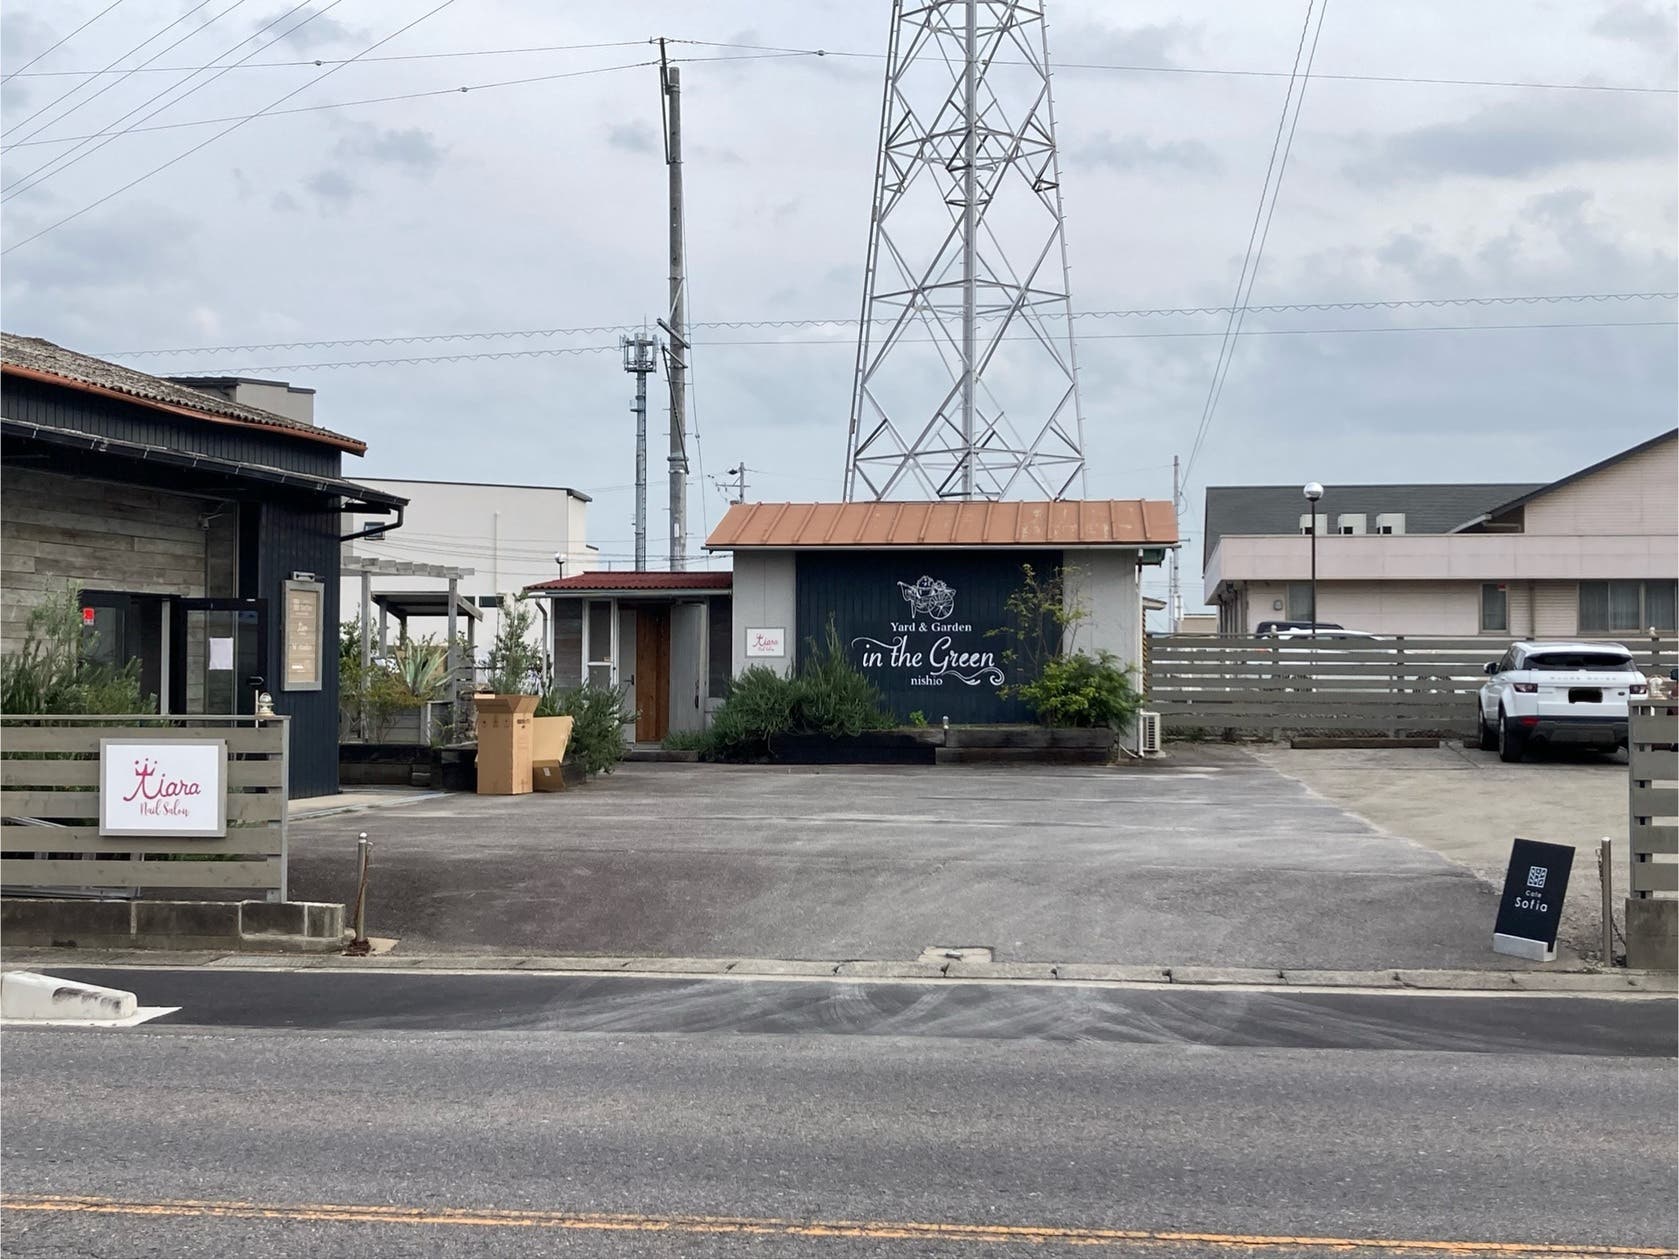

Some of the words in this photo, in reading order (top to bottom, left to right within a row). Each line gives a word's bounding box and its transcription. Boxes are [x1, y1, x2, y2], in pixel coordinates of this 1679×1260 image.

[891, 622, 915, 632] Yard
[919, 622, 928, 632] &
[931, 622, 972, 632] Garden
[862, 644, 883, 668] in
[890, 635, 923, 668] the
[929, 636, 995, 676] Green
[910, 675, 943, 686] nishio
[1514, 896, 1548, 912] Sofia
